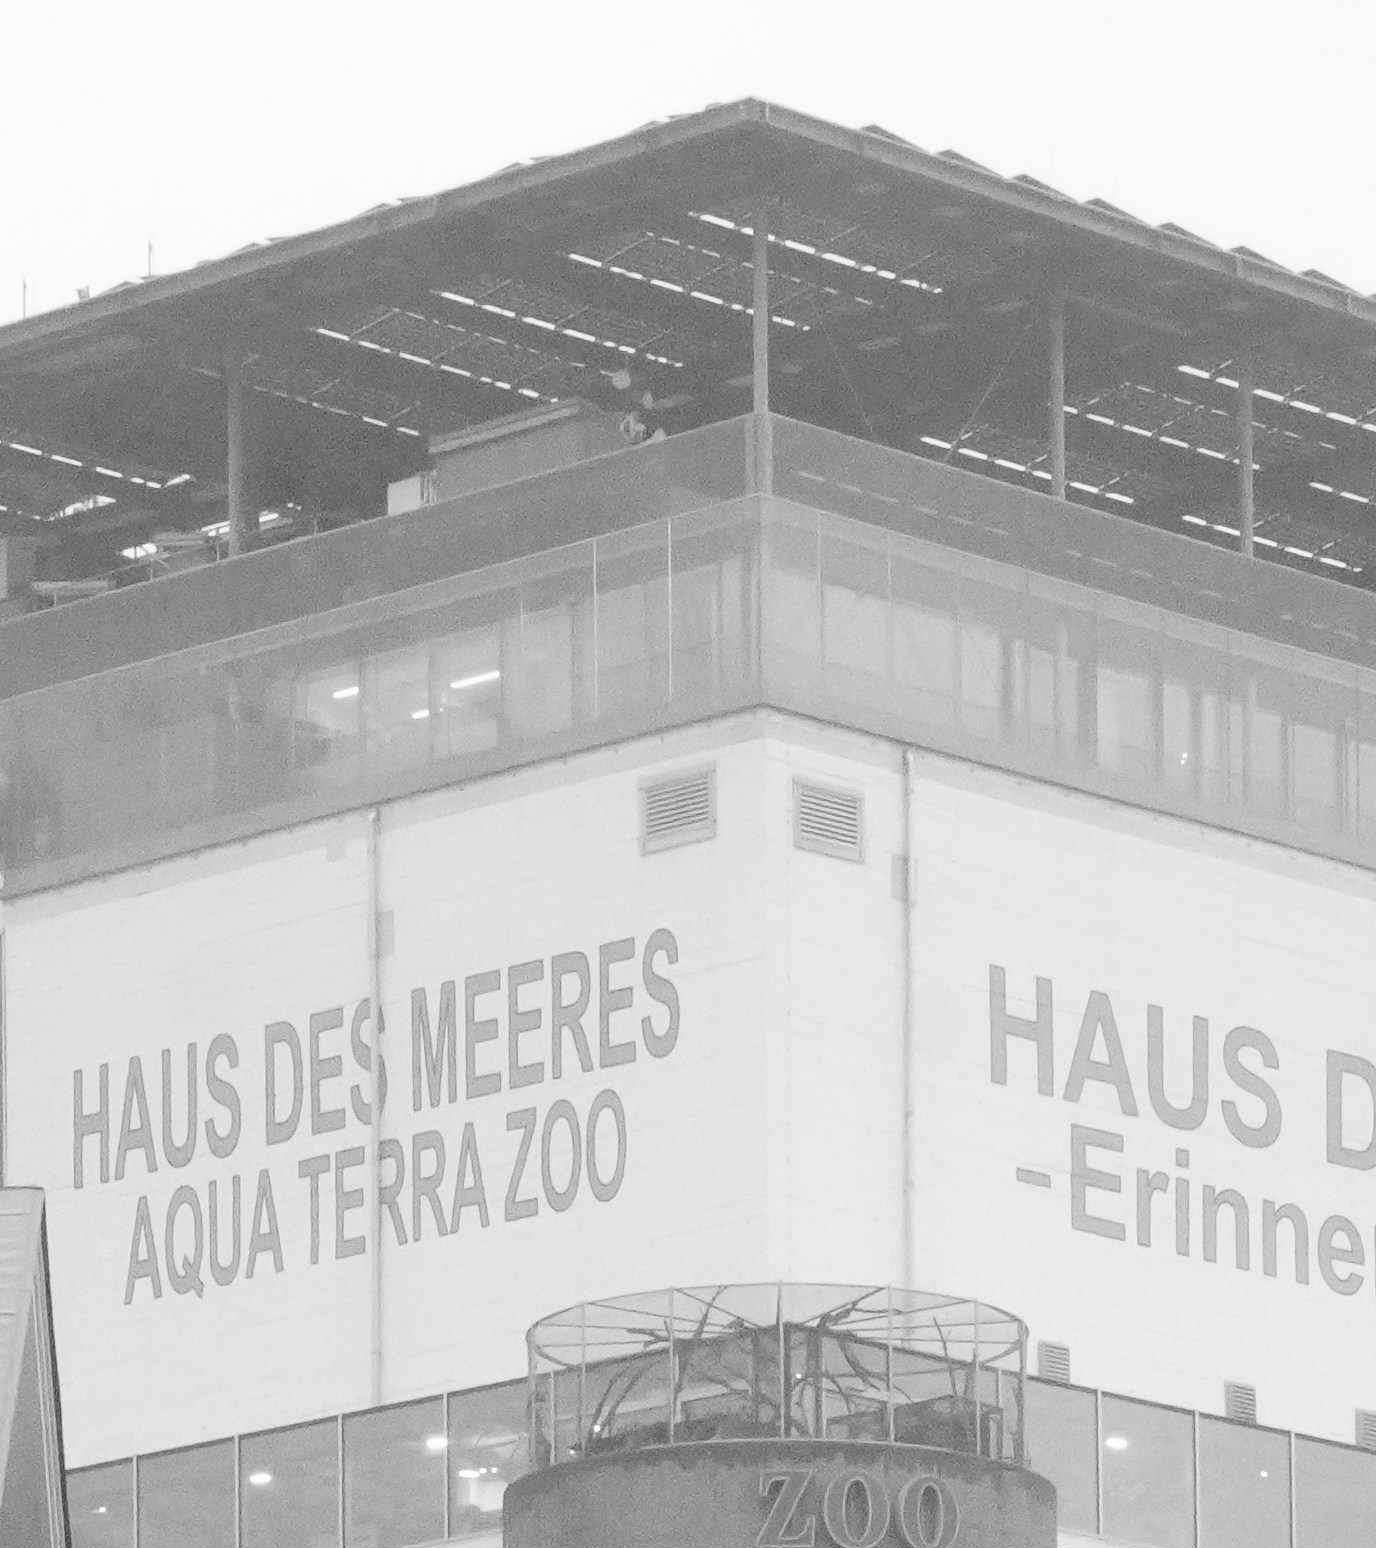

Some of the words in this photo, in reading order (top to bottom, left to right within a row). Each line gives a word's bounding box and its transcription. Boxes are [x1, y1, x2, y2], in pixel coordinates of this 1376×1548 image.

[73, 1032, 242, 1190] HAUS
[265, 997, 388, 1146] DES
[411, 927, 681, 1112] MEERES
[988, 964, 1283, 1149] HAUS
[124, 1168, 284, 1305] AQUA
[298, 1121, 490, 1266] TERRA
[504, 1088, 627, 1223] ZOO
